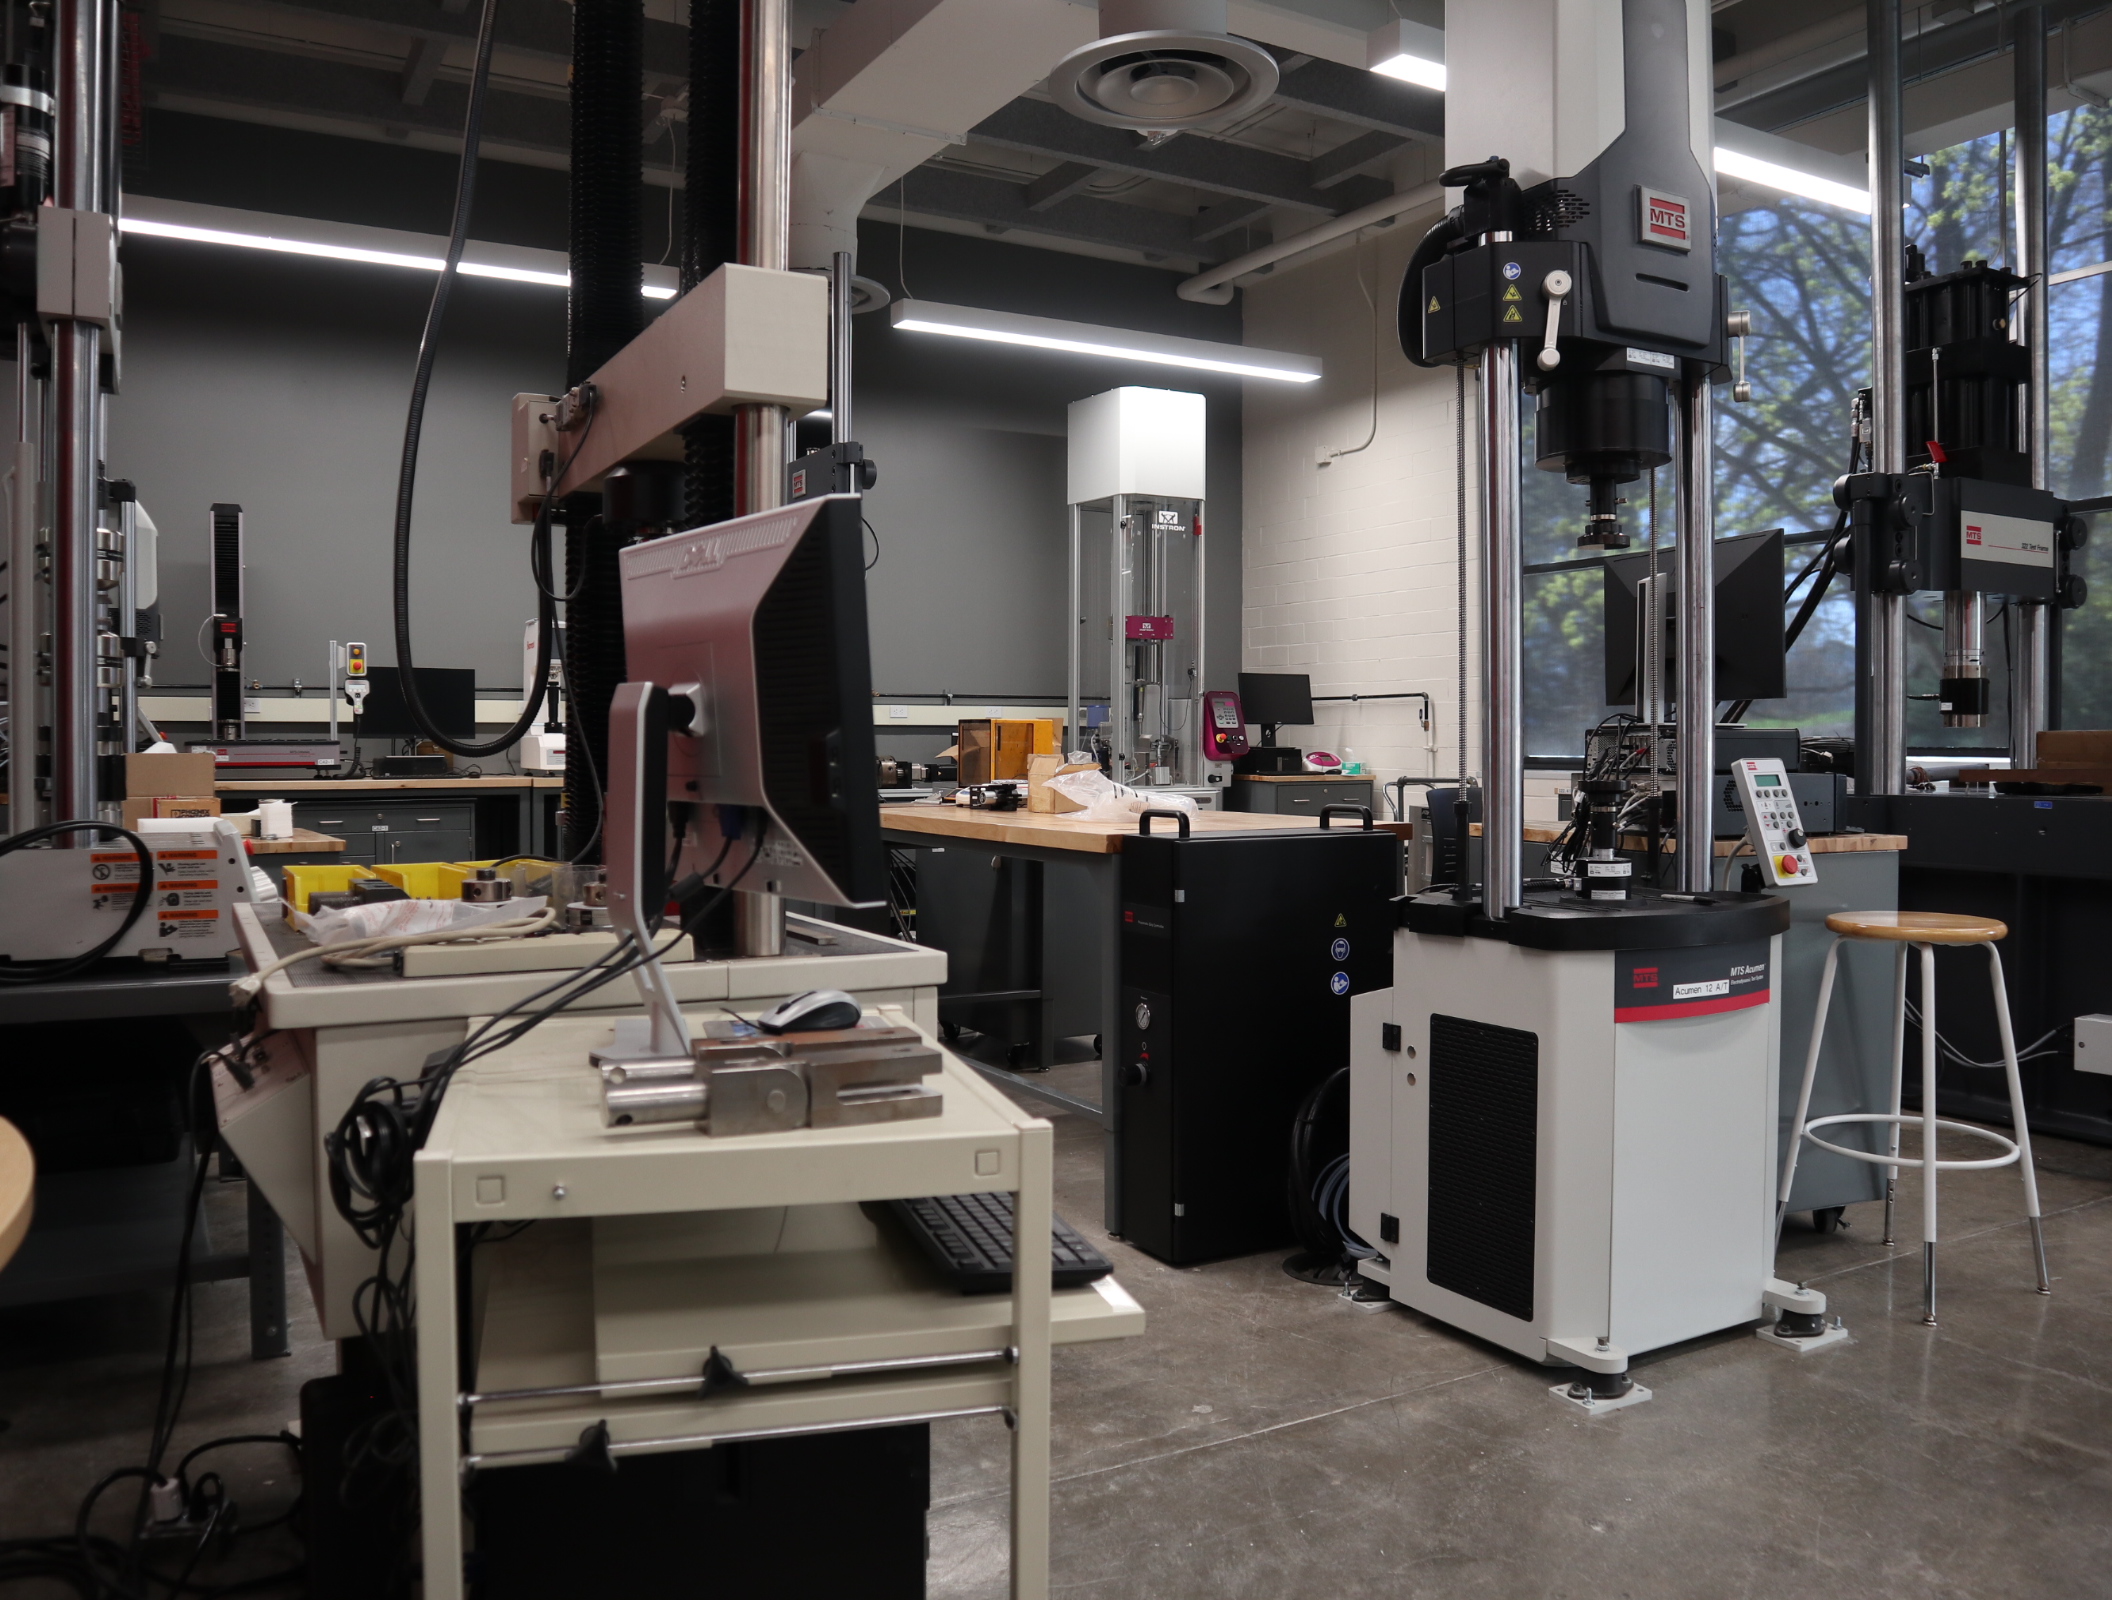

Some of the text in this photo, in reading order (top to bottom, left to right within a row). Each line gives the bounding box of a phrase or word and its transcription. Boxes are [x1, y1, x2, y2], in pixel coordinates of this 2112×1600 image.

[1650, 208, 1685, 229] MTS
[1966, 532, 1981, 540] MTS
[1730, 964, 1765, 977] MTS Acumen
[1633, 973, 1658, 982] MTS
[1675, 982, 1728, 996] Acumen 12 A/T
